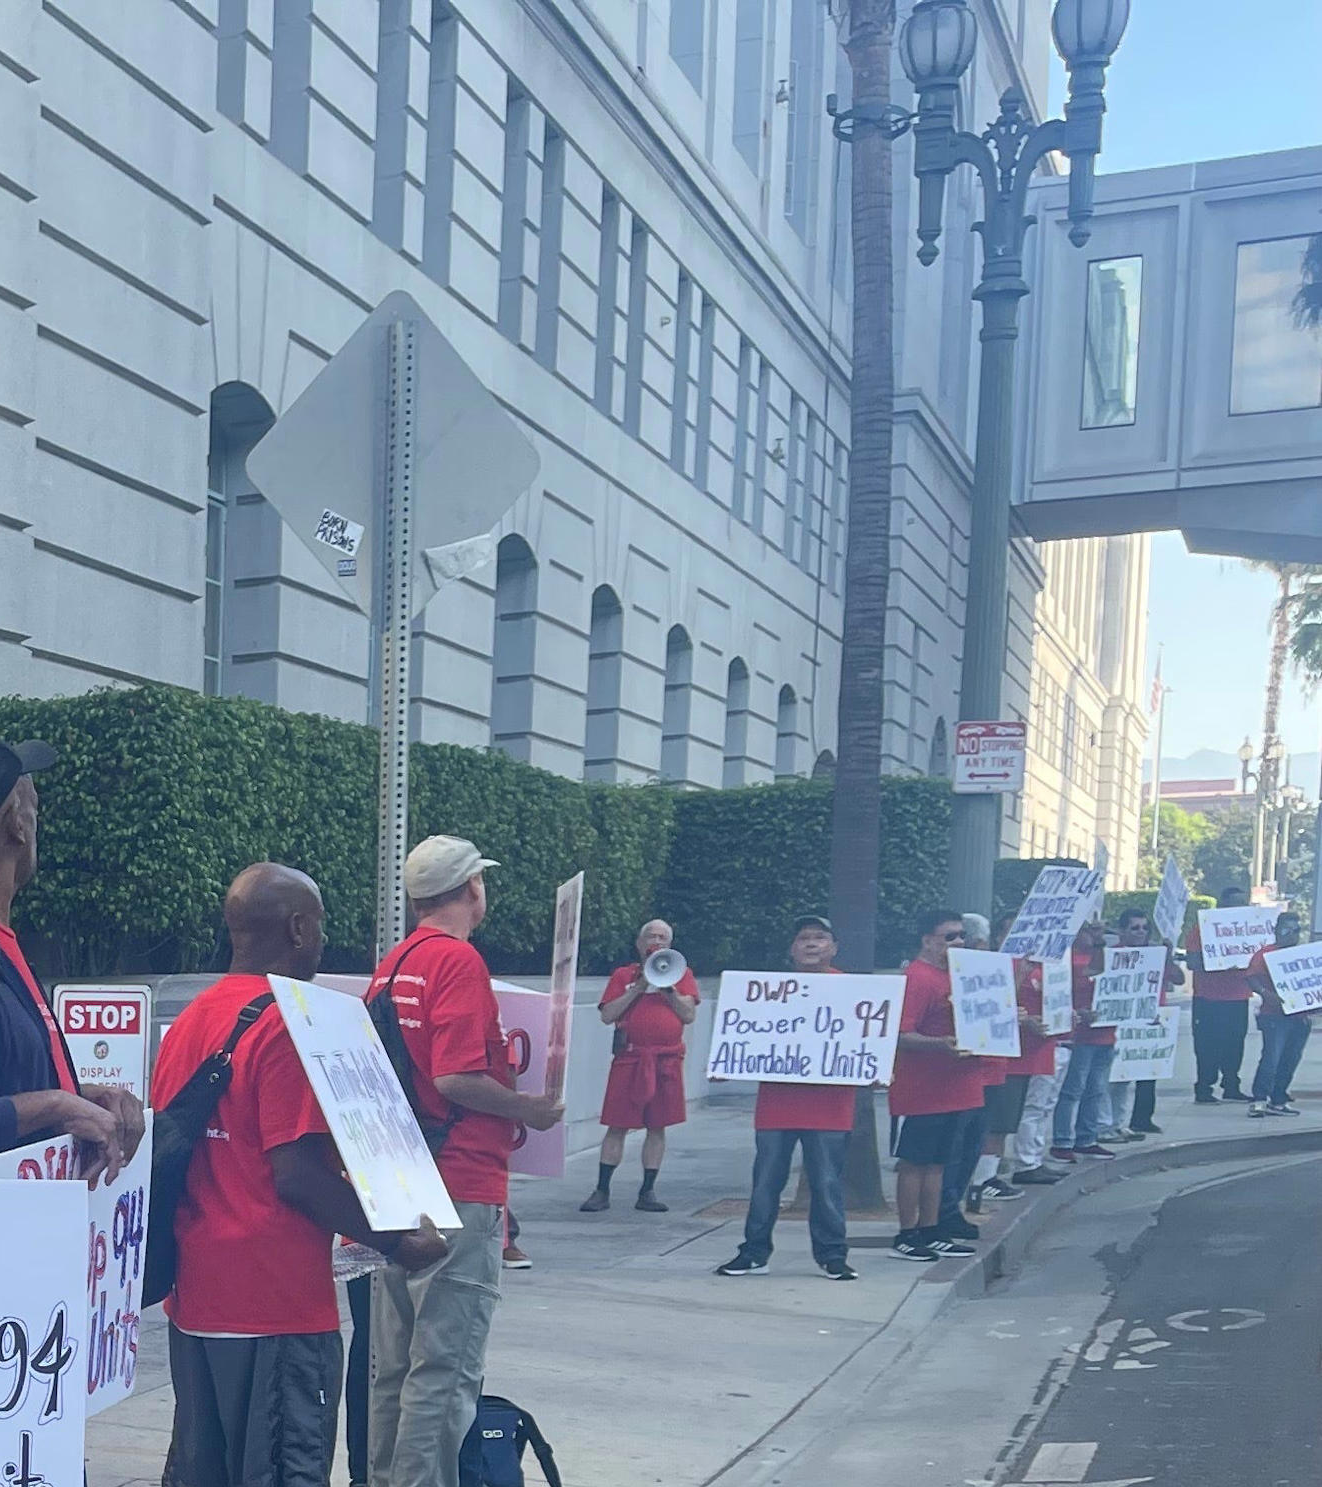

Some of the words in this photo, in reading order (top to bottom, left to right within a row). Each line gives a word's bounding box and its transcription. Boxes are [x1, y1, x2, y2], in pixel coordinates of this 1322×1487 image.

[958, 737, 978, 753] NO
[982, 740, 1023, 752] STOPPING
[965, 757, 986, 768] ANY
[991, 756, 1016, 768] TIME
[746, 978, 809, 1003] DWP:
[69, 1005, 137, 1029] STOP
[721, 1008, 806, 1035] Power
[814, 1006, 845, 1039] Up
[855, 1000, 890, 1038] 94
[80, 1067, 123, 1078] DISPLAY
[711, 1041, 811, 1076] Affordable
[821, 1041, 879, 1080] Units
[113, 1186, 144, 1289] 94
[88, 1280, 141, 1395] Units
